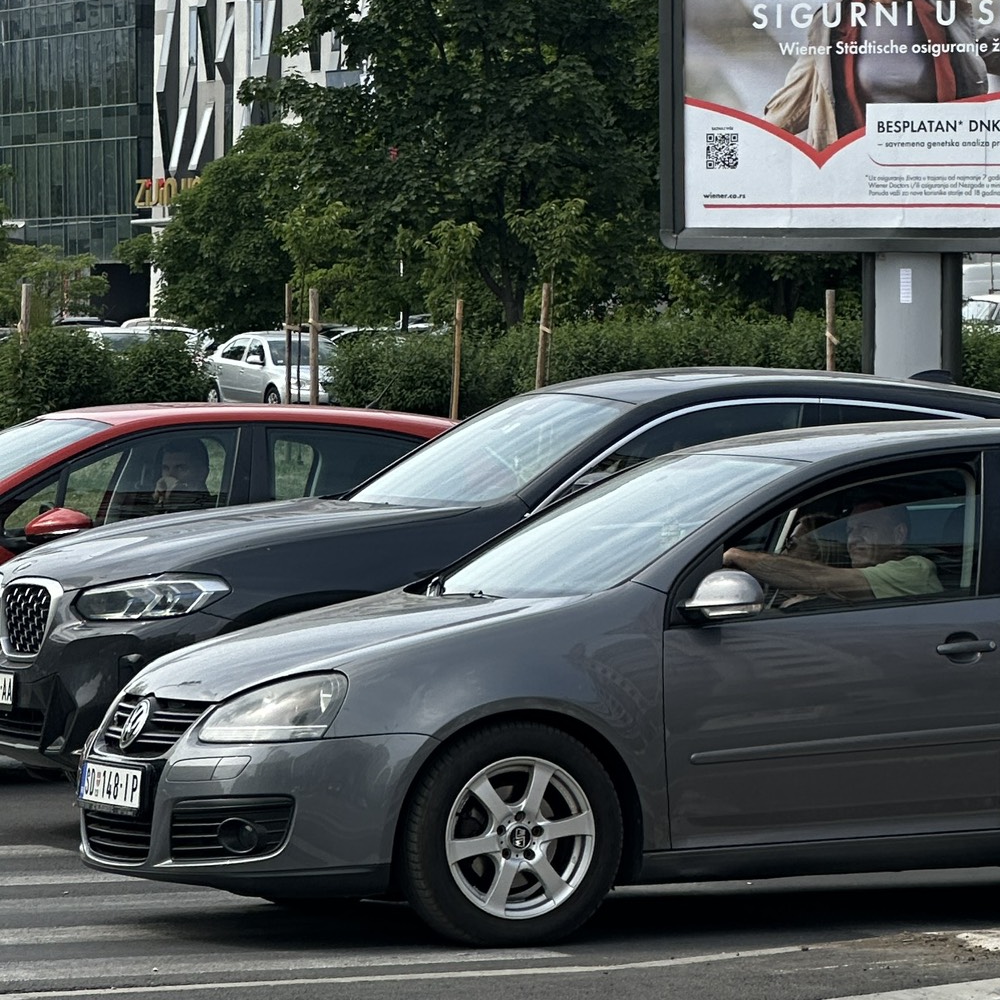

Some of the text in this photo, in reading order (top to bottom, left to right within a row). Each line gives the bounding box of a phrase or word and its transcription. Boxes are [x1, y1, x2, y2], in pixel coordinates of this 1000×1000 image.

[752, 1, 914, 29] SIGURNI
[935, 0, 956, 26] U
[779, 41, 832, 56] Wiener
[835, 39, 908, 55] Städtische
[911, 39, 988, 57] osiguranje
[969, 119, 1000, 132] DNK
[927, 139, 959, 149] genetska
[962, 139, 990, 147] analiza
[85, 768, 96, 796] SD
